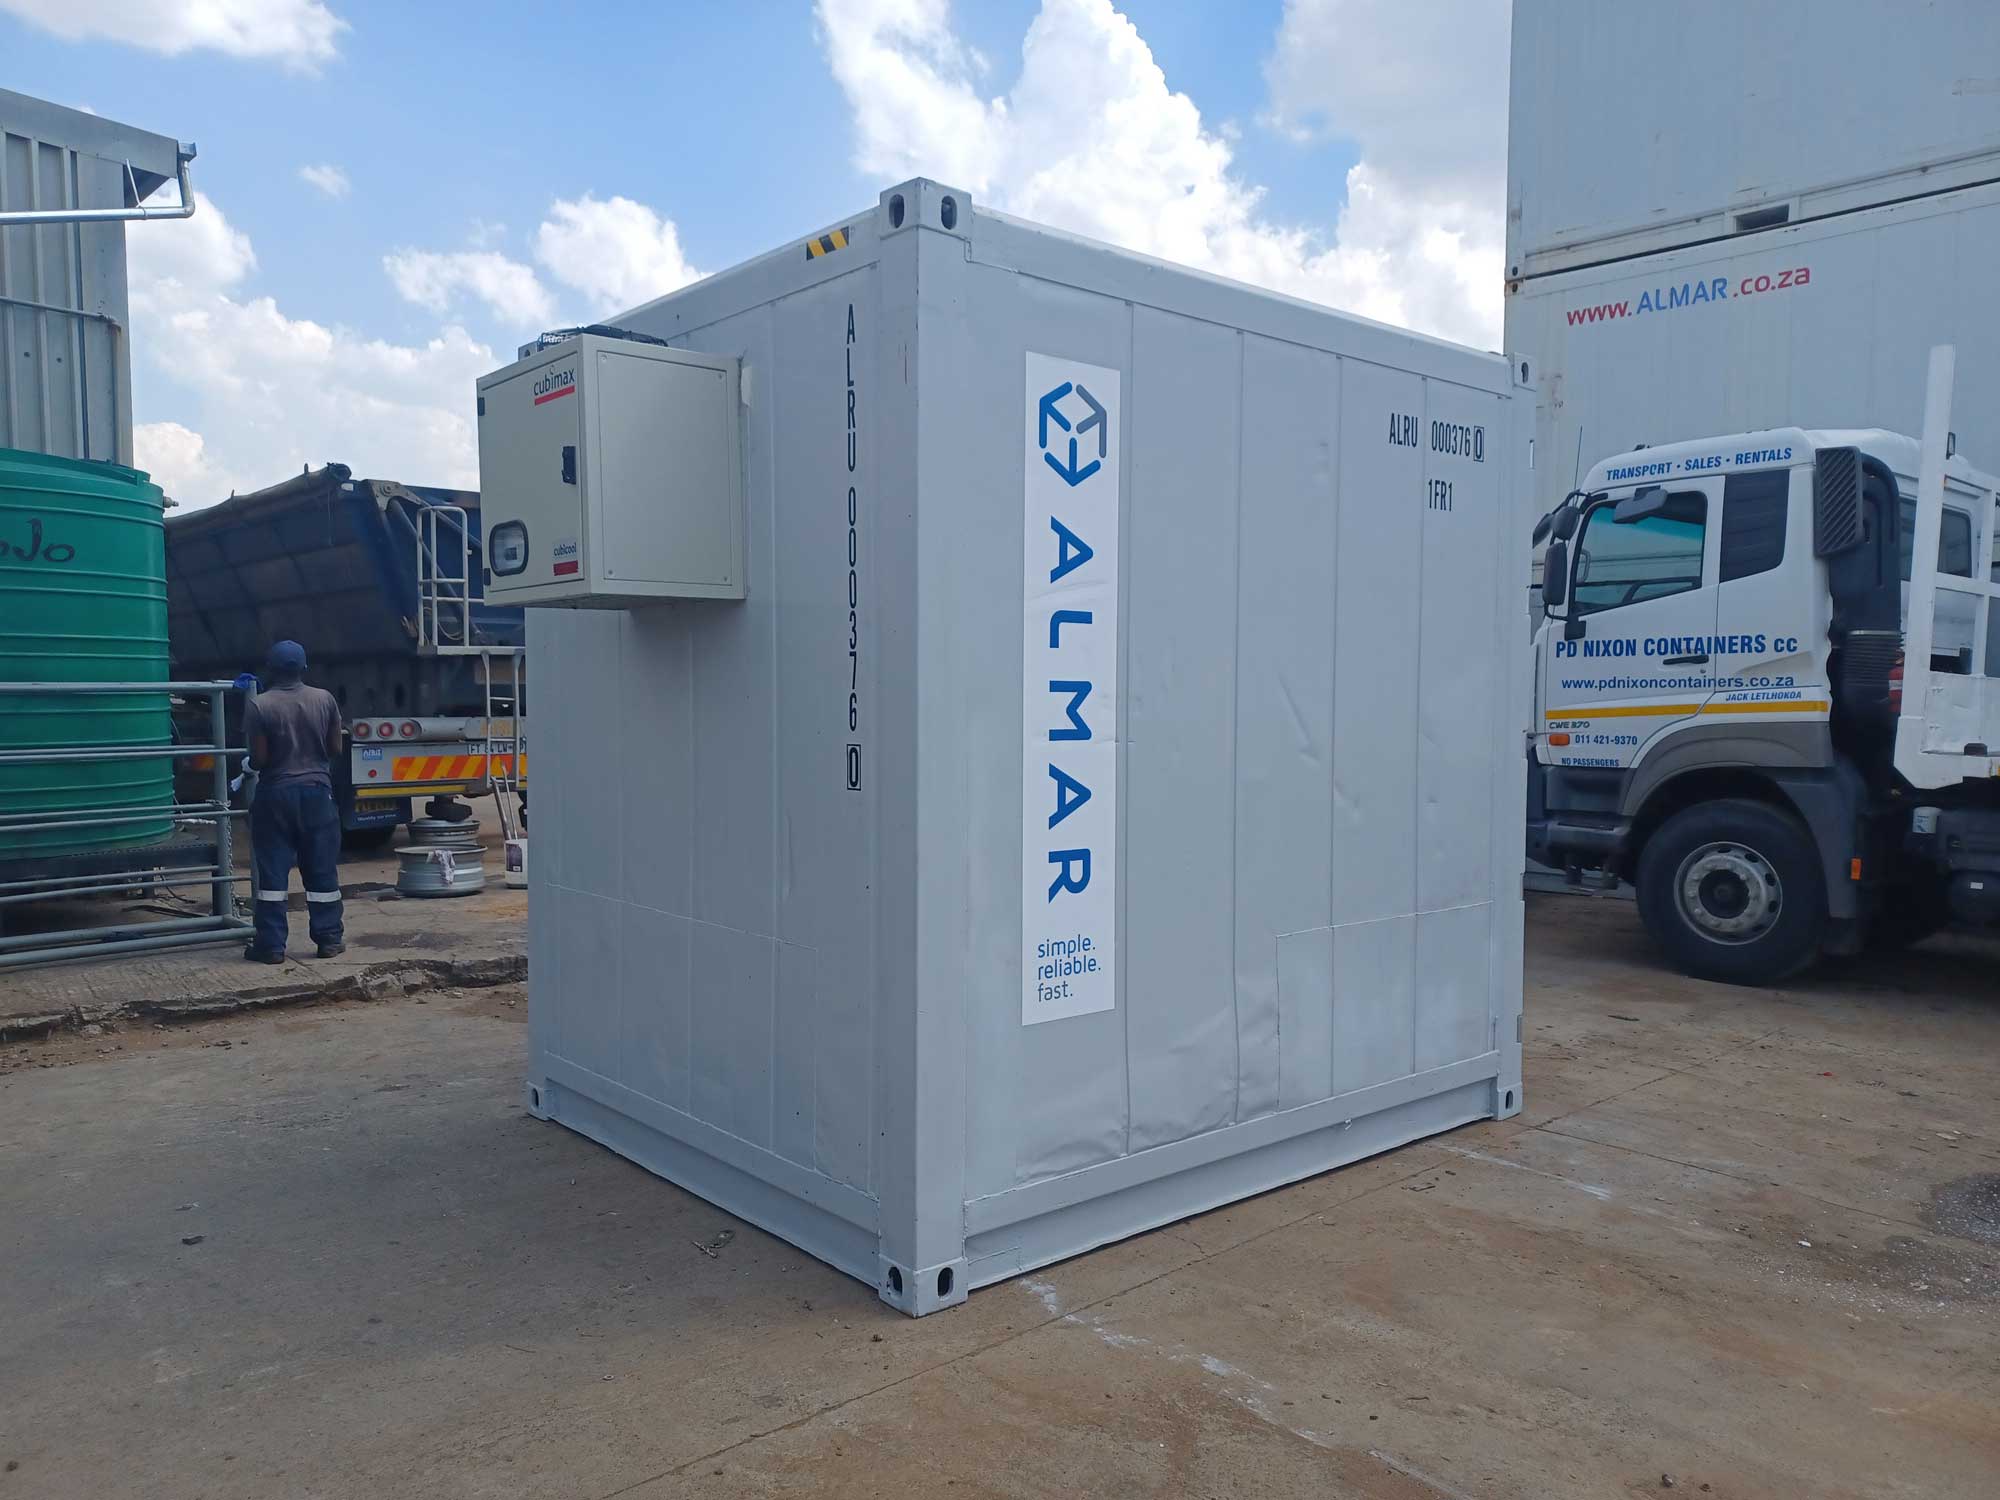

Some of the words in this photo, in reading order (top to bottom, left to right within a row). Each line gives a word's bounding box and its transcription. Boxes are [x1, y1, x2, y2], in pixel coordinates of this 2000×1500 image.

[533, 367, 575, 396] cubimax
[847, 303, 856, 472] ALRU
[1388, 412, 1418, 448] ALRU
[1431, 420, 1471, 457] 000376
[1606, 462, 1672, 481] TRANSPORT
[1684, 455, 1722, 472] SALES
[1735, 447, 1792, 466] RENTALS
[553, 541, 577, 557] cubicool
[849, 486, 857, 732] 000376
[1556, 641, 1577, 658] PD
[1583, 638, 1637, 657] NIXON
[1643, 634, 1766, 656] CONTAINERS
[1561, 676, 1794, 692] www.pdnixoncontainers.co.za
[1726, 692, 1749, 701] JACK
[1048, 514, 1094, 904] ALMAR
[1549, 721, 1570, 729] CWE
[1575, 735, 1590, 744] 011
[1593, 736, 1638, 745] 421-9370
[849, 746, 859, 788] 0
[1561, 758, 1571, 766] NO
[1573, 758, 1619, 767] PASSENGERS
[1037, 933, 1096, 958] simple.
[1038, 954, 1101, 980] reliable.
[1037, 980, 1073, 1003] fast.
